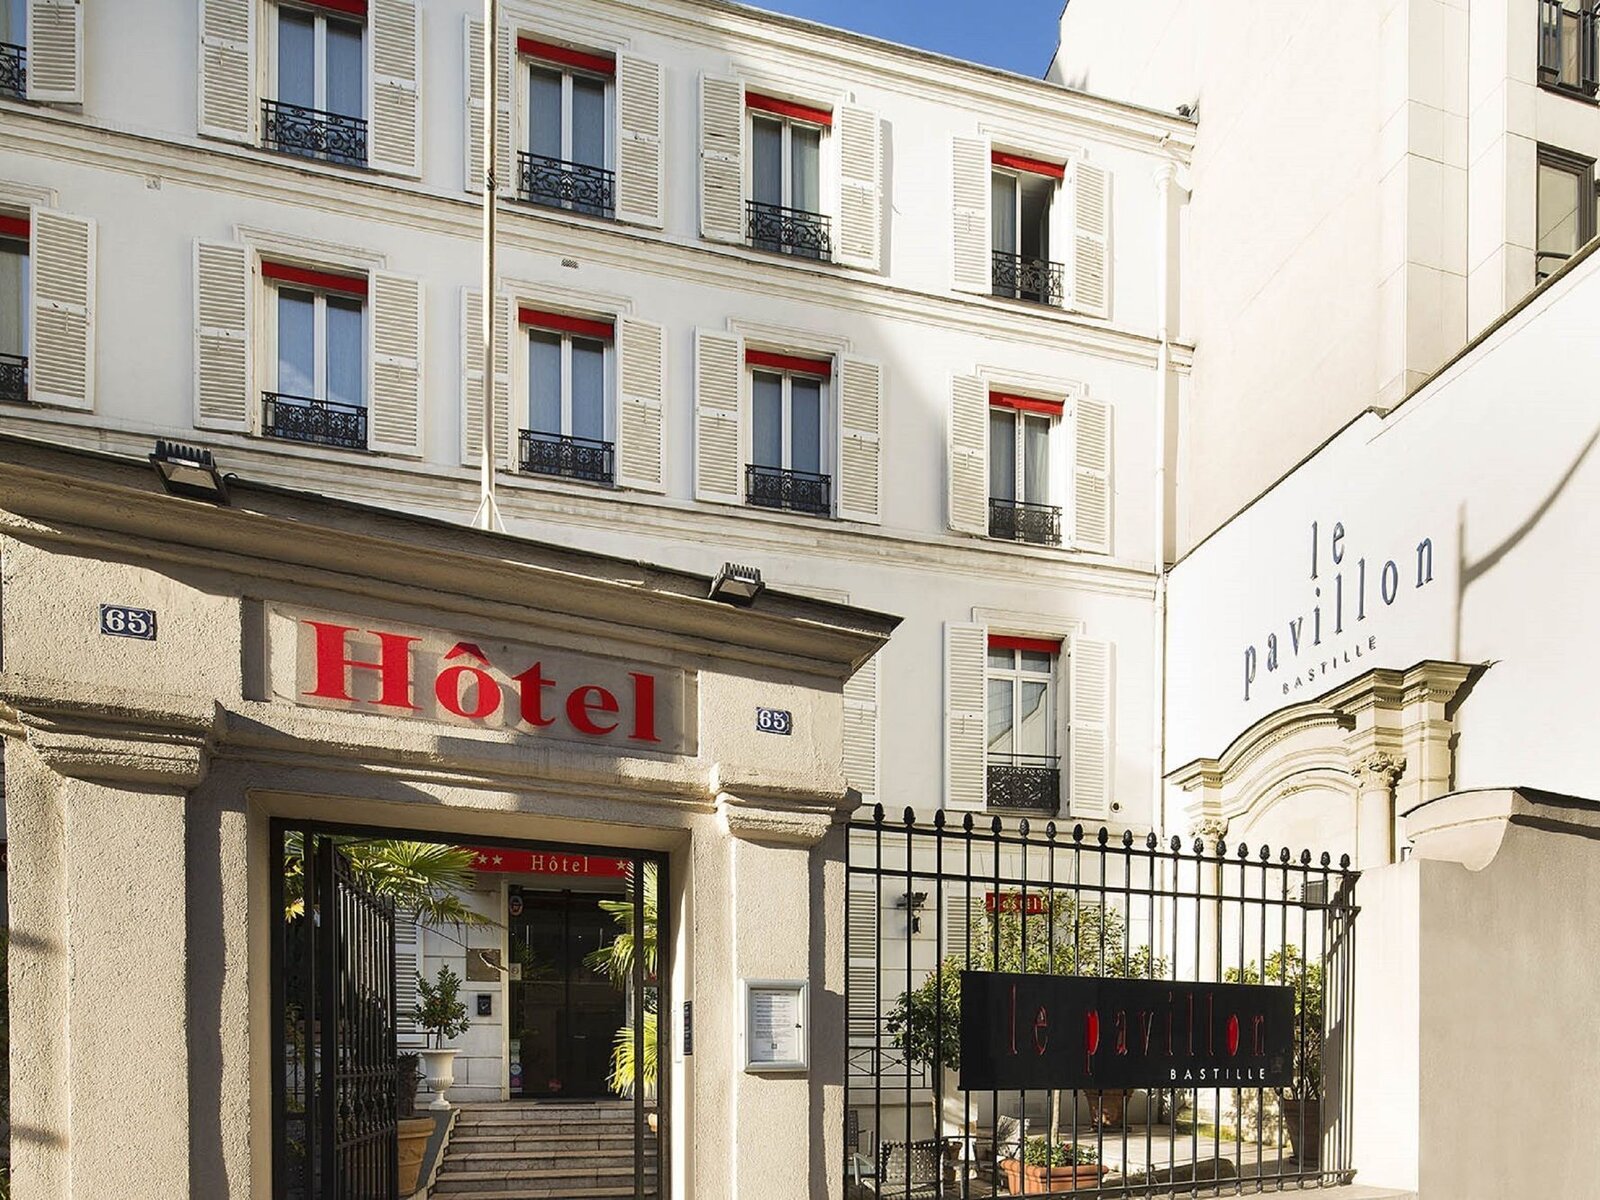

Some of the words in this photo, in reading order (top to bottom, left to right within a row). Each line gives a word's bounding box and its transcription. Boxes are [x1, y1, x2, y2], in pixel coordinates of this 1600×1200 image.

[1310, 521, 1345, 580] le
[105, 609, 148, 634] 65
[1244, 537, 1434, 701] pavillon
[301, 620, 662, 743] Hôtel
[1282, 634, 1377, 695] BASTILLE
[759, 710, 786, 730] 65
[530, 854, 590, 874] Hôtel
[1008, 983, 1049, 1056] le
[1083, 991, 1265, 1076] pavillon
[1170, 1067, 1267, 1081] BASTILLE
